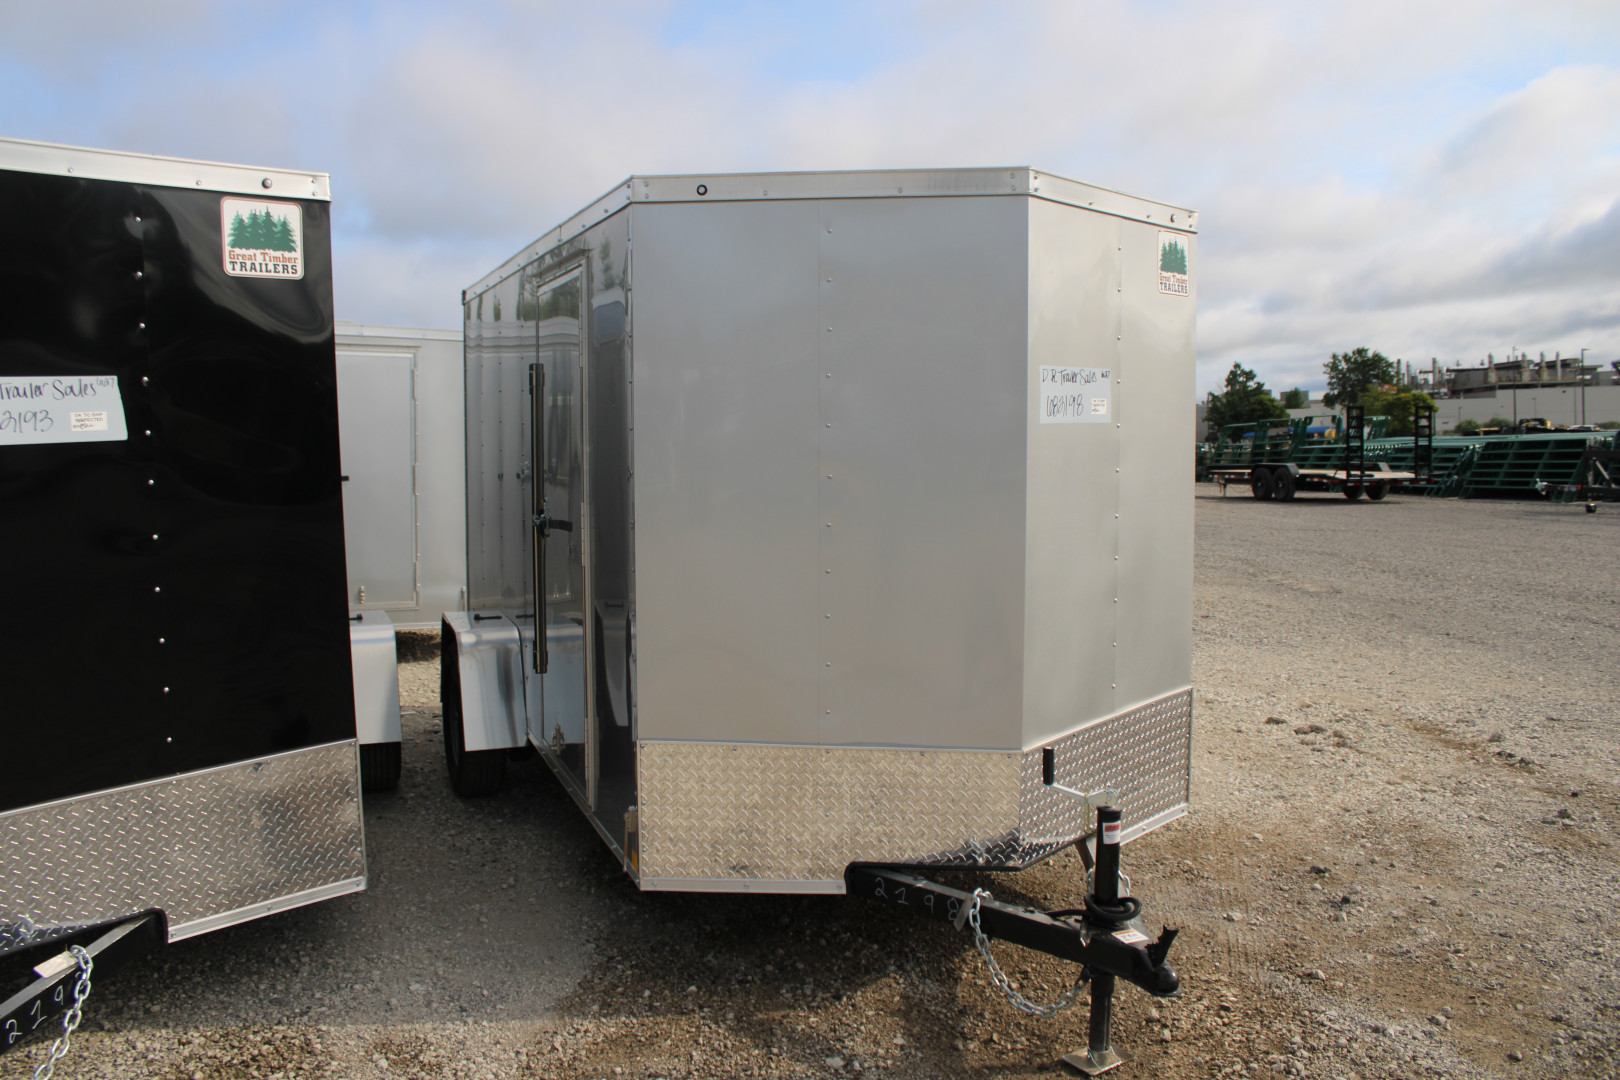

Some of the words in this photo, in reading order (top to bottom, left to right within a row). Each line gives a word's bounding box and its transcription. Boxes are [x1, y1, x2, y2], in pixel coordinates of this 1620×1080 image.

[228, 249, 257, 262] Great
[260, 251, 298, 264] Timber
[229, 261, 298, 275] TRAILERS
[1160, 281, 1188, 294] TRAILERS
[1080, 369, 1097, 386] Sales
[0, 382, 49, 400] Trailer
[52, 379, 97, 401] Sales
[875, 877, 959, 920] 2198
